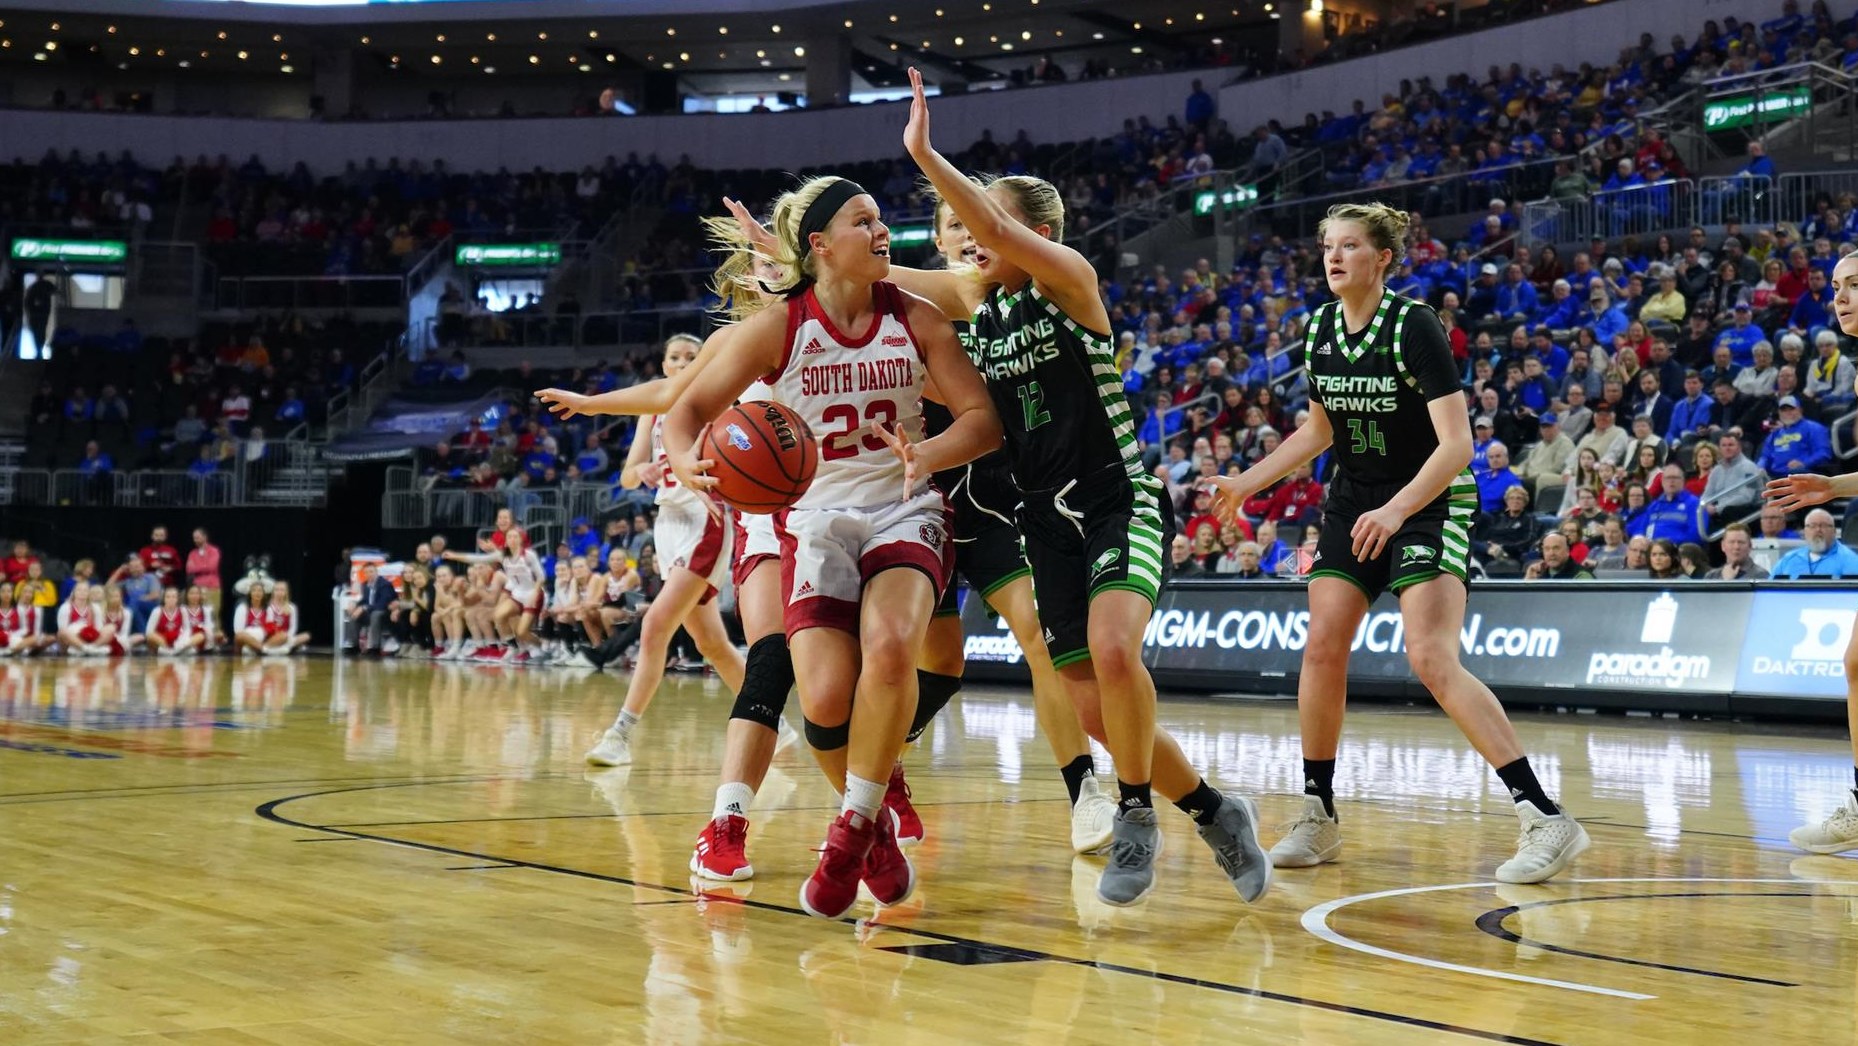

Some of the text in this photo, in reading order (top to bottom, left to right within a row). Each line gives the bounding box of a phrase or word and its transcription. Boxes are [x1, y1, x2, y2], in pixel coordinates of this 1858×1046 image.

[801, 357, 913, 397] SOUTH DAKOTA
[1315, 374, 1398, 394] FIGHTING
[1017, 381, 1051, 432] 12
[1321, 395, 1398, 413] HAWKS
[822, 399, 897, 462] 23
[1347, 418, 1387, 456] 34
[1586, 645, 1711, 688] paradigm
[1752, 656, 1846, 678] DAKTRO
